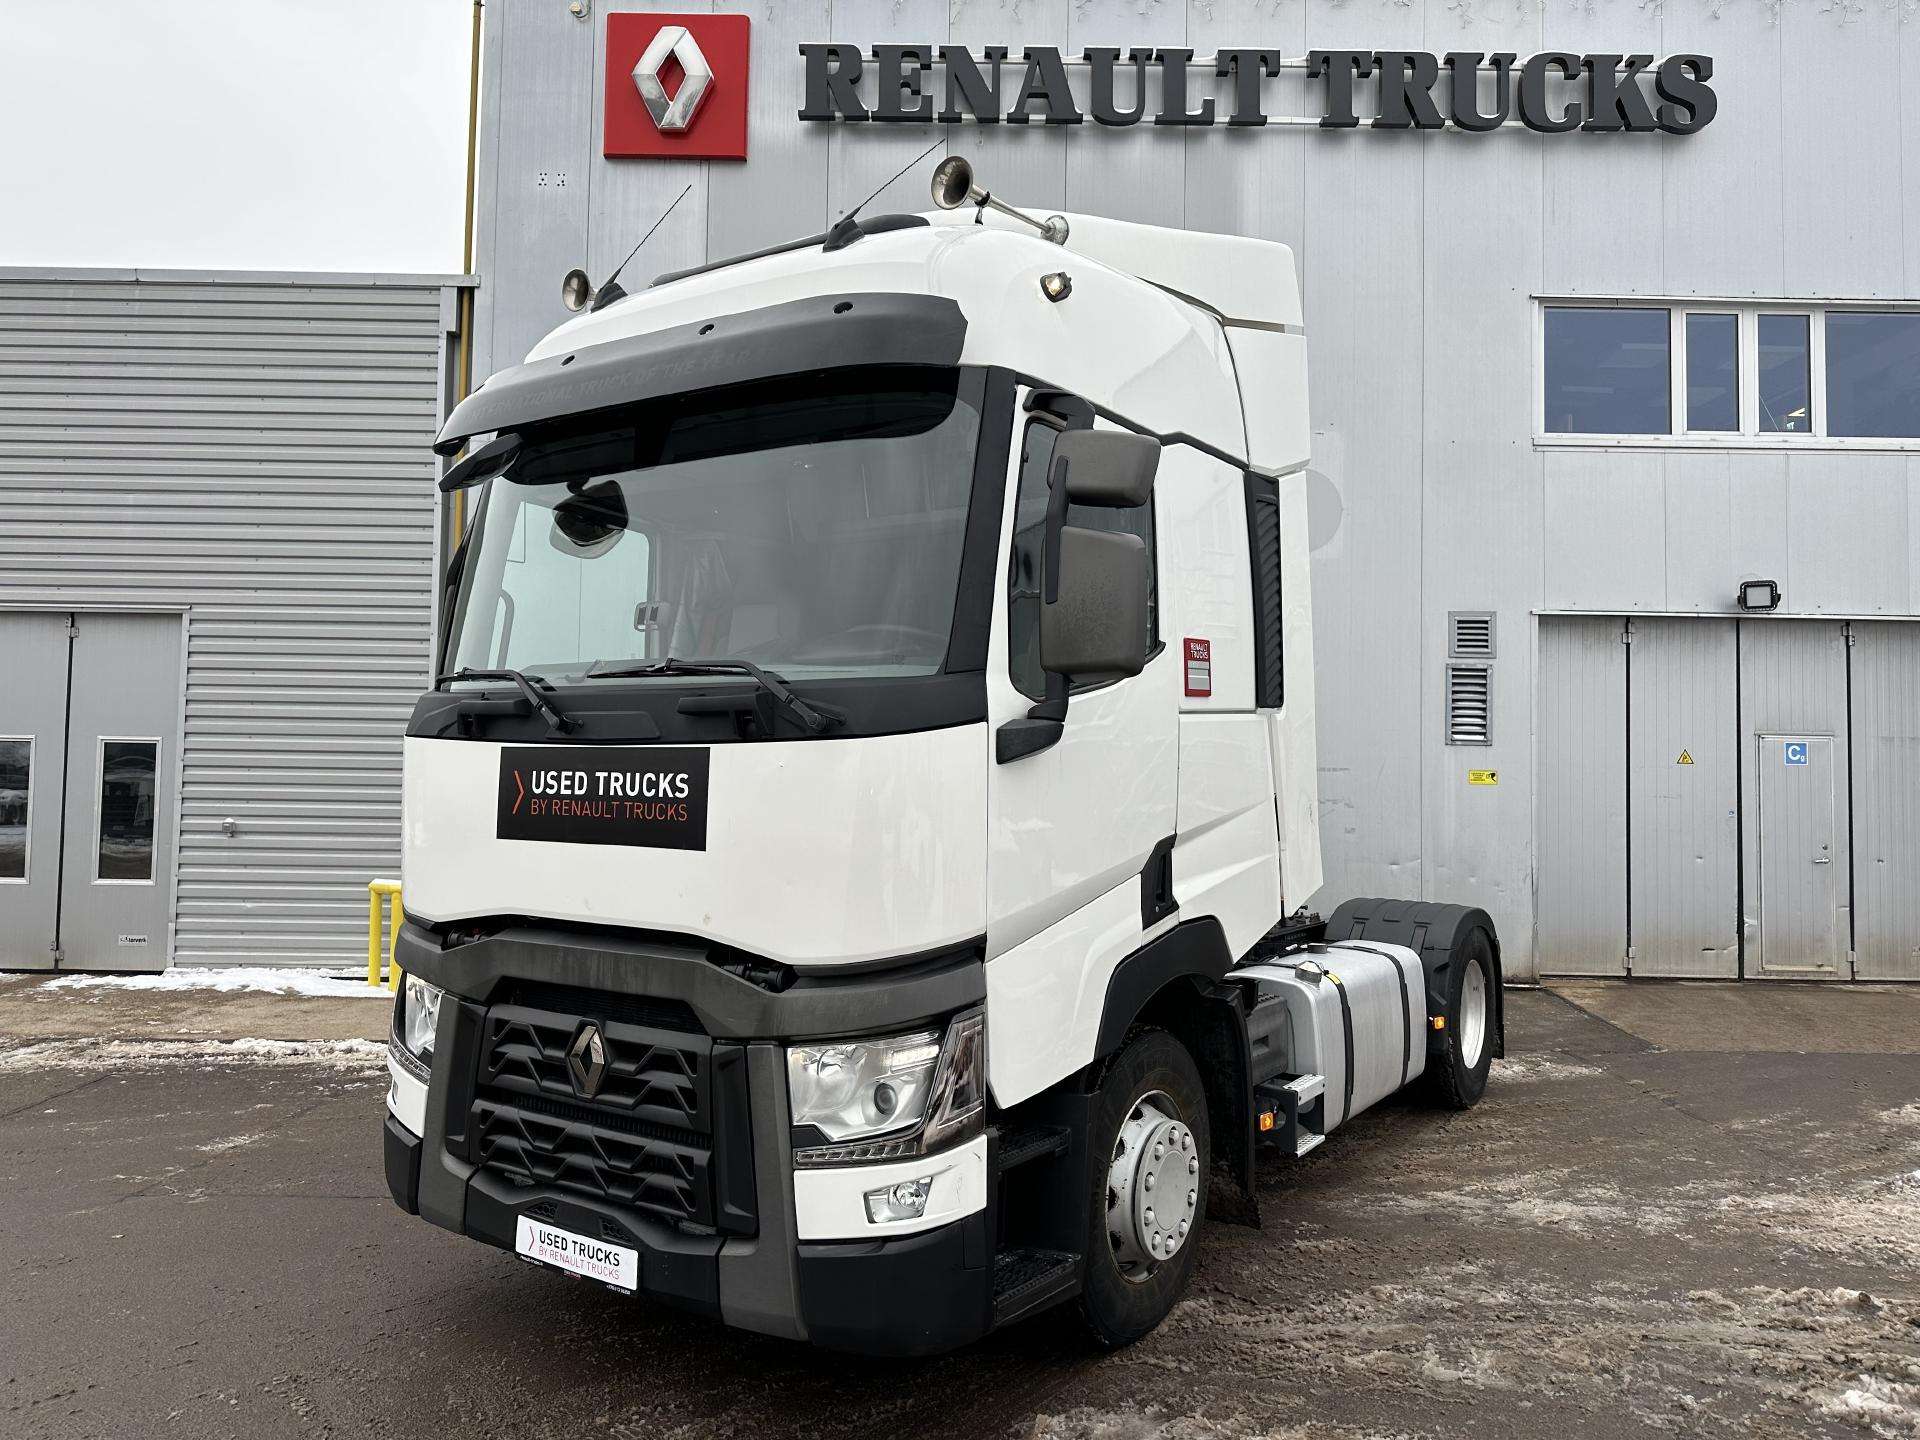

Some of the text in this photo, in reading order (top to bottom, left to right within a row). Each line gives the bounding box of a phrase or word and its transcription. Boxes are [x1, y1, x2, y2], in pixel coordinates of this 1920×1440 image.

[798, 43, 1718, 134] RENAULT TRUCKS
[532, 771, 689, 799] USED TRUCKS
[531, 799, 688, 821] BY RENAULT TRUCKS
[539, 1230, 568, 1251] USED
[572, 1240, 620, 1266] TRUCKS
[539, 1246, 548, 1256] BY
[549, 1250, 584, 1269] RENAULT
[587, 1261, 620, 1280] TRUCKS
